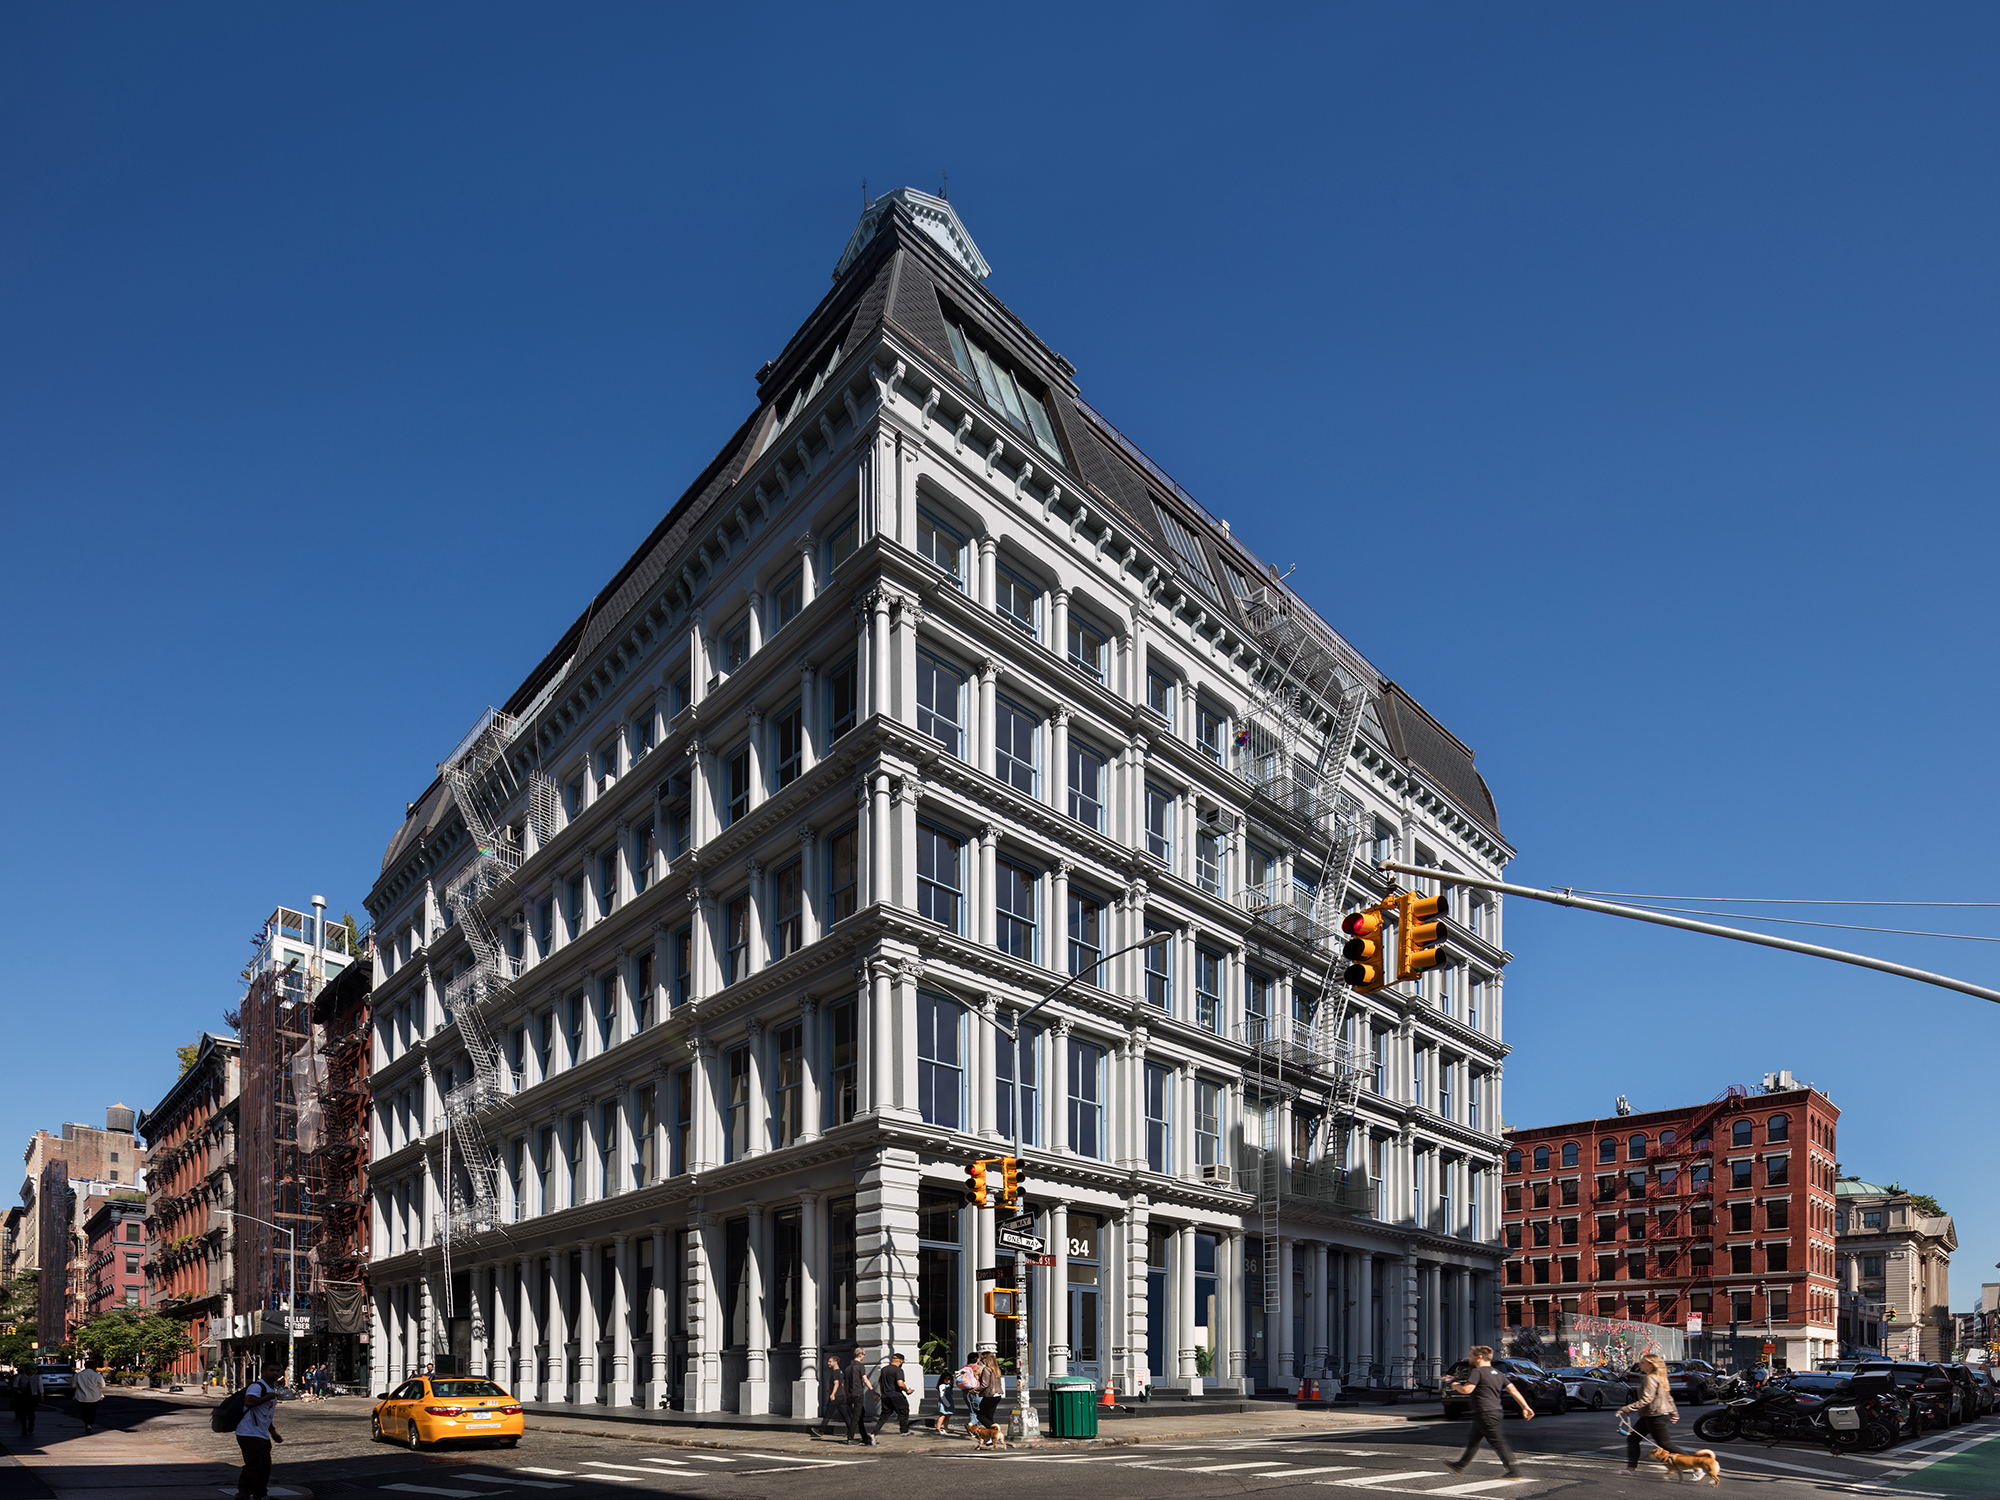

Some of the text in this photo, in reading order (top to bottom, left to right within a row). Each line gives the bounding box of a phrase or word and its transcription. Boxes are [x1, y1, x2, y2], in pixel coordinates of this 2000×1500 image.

[1016, 1218, 1029, 1227] WAY
[1006, 1234, 1039, 1248] ONE WAY
[1044, 1256, 1051, 1265] St
[996, 1268, 1004, 1277] St
[284, 1322, 311, 1330] BRBER
